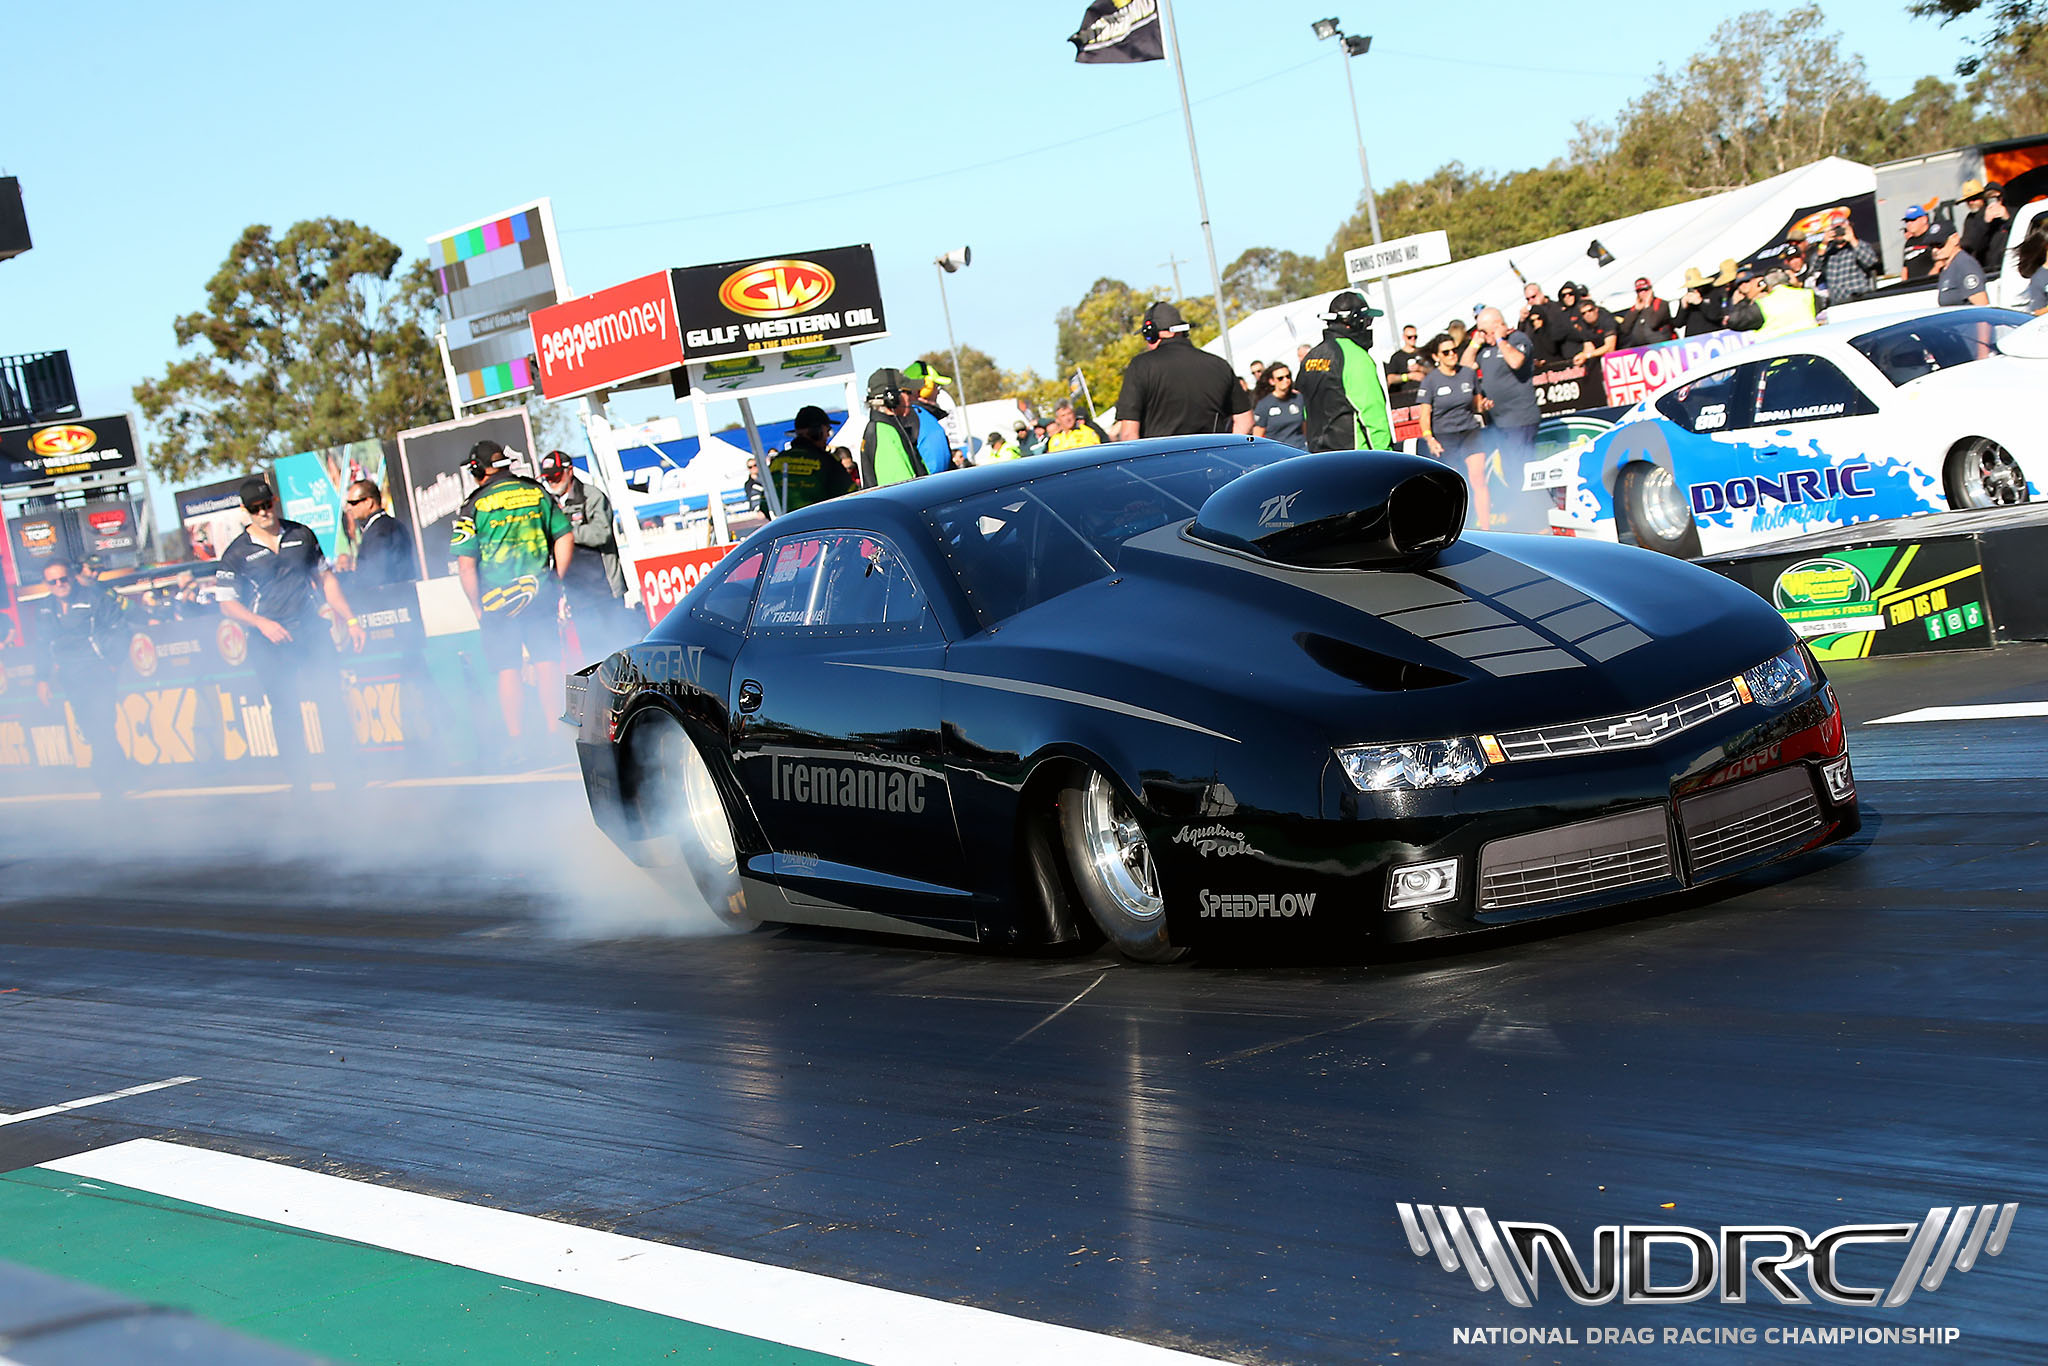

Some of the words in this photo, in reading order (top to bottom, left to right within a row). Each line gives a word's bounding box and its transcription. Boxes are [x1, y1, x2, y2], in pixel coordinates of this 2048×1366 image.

[1350, 255, 1375, 274] DENNIS
[1405, 245, 1419, 260] WAY
[541, 298, 666, 376] peppermoney
[686, 325, 740, 348] GULF
[743, 311, 841, 341] WESTERN
[844, 307, 880, 327] OIL
[1641, 344, 1687, 387] ON
[1547, 381, 1580, 403] 4289
[1791, 403, 1845, 419] MACLEAN
[1690, 464, 1875, 515] DONRIC
[1751, 492, 1840, 533] Motorsport
[1842, 604, 1875, 616] FINEST
[1889, 600, 1915, 626] FIND
[1914, 593, 1932, 618] US
[1930, 588, 1949, 612] ON
[1802, 624, 1825, 632] SINCE
[855, 752, 922, 766] RACING
[762, 747, 926, 814] Tremaniac
[1172, 823, 1246, 847] Aqualine
[1196, 840, 1265, 858] Pools
[782, 849, 819, 867] DIAMOND
[1200, 888, 1317, 918] SPEEDFLOW
